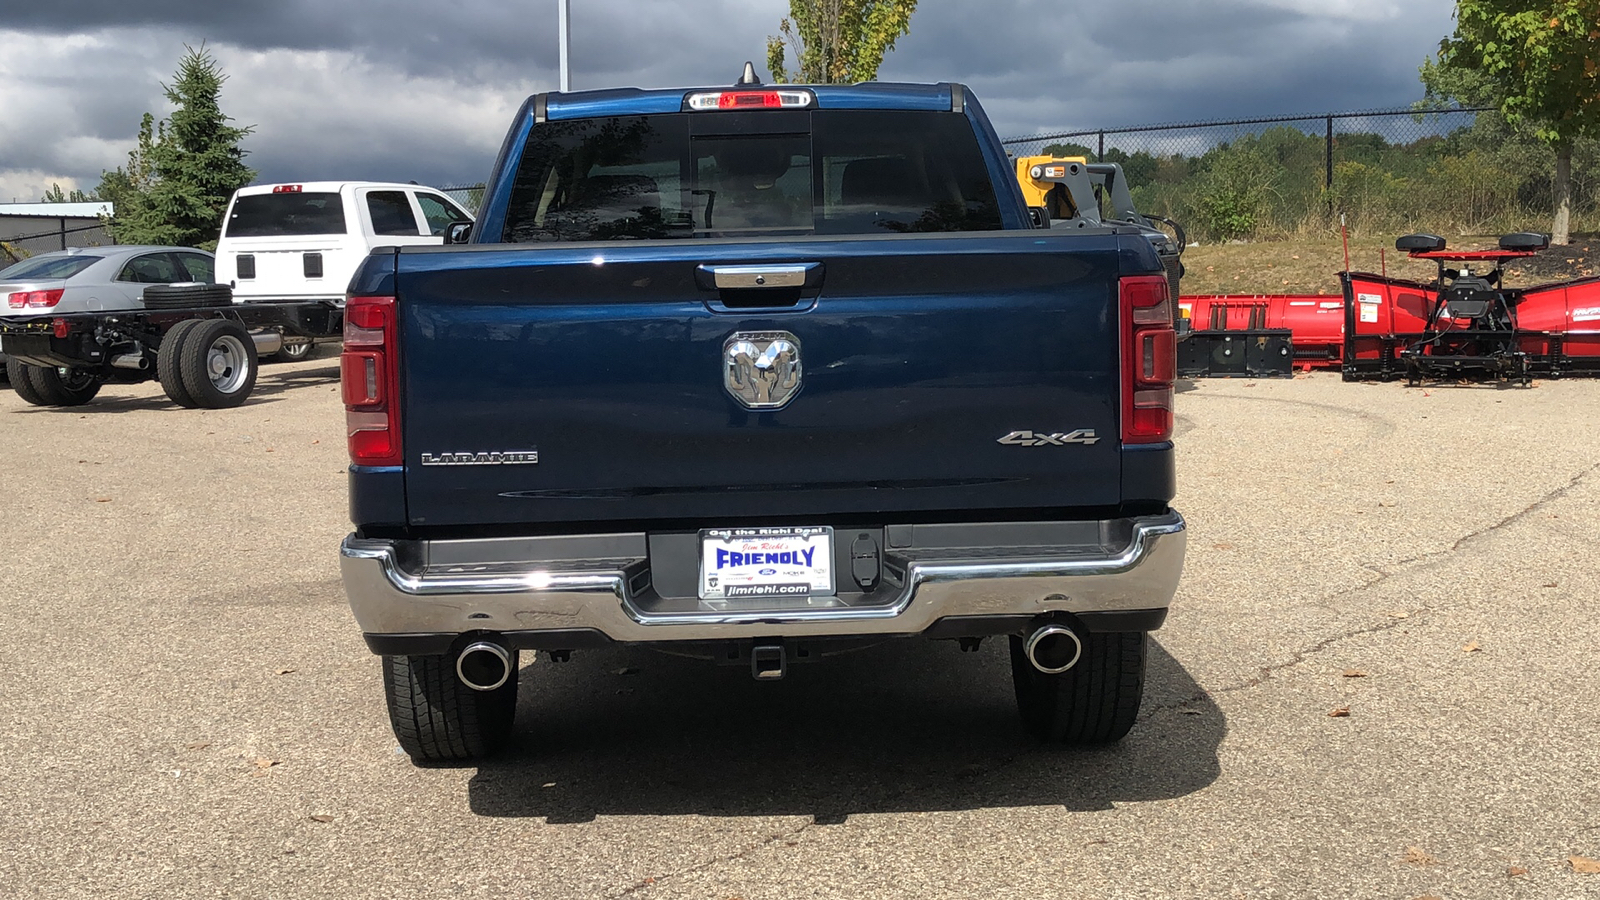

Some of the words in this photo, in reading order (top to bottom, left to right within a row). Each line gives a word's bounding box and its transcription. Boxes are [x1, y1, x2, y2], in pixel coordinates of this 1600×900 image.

[422, 452, 538, 465] LARAMIE
[735, 528, 756, 536] the
[759, 527, 791, 535] Riehl
[794, 527, 823, 535] Deal
[741, 543, 758, 552] Jim
[761, 542, 789, 551] Riehl's
[716, 545, 815, 570] FRIENDLY
[727, 585, 808, 596] jimriehl.com
